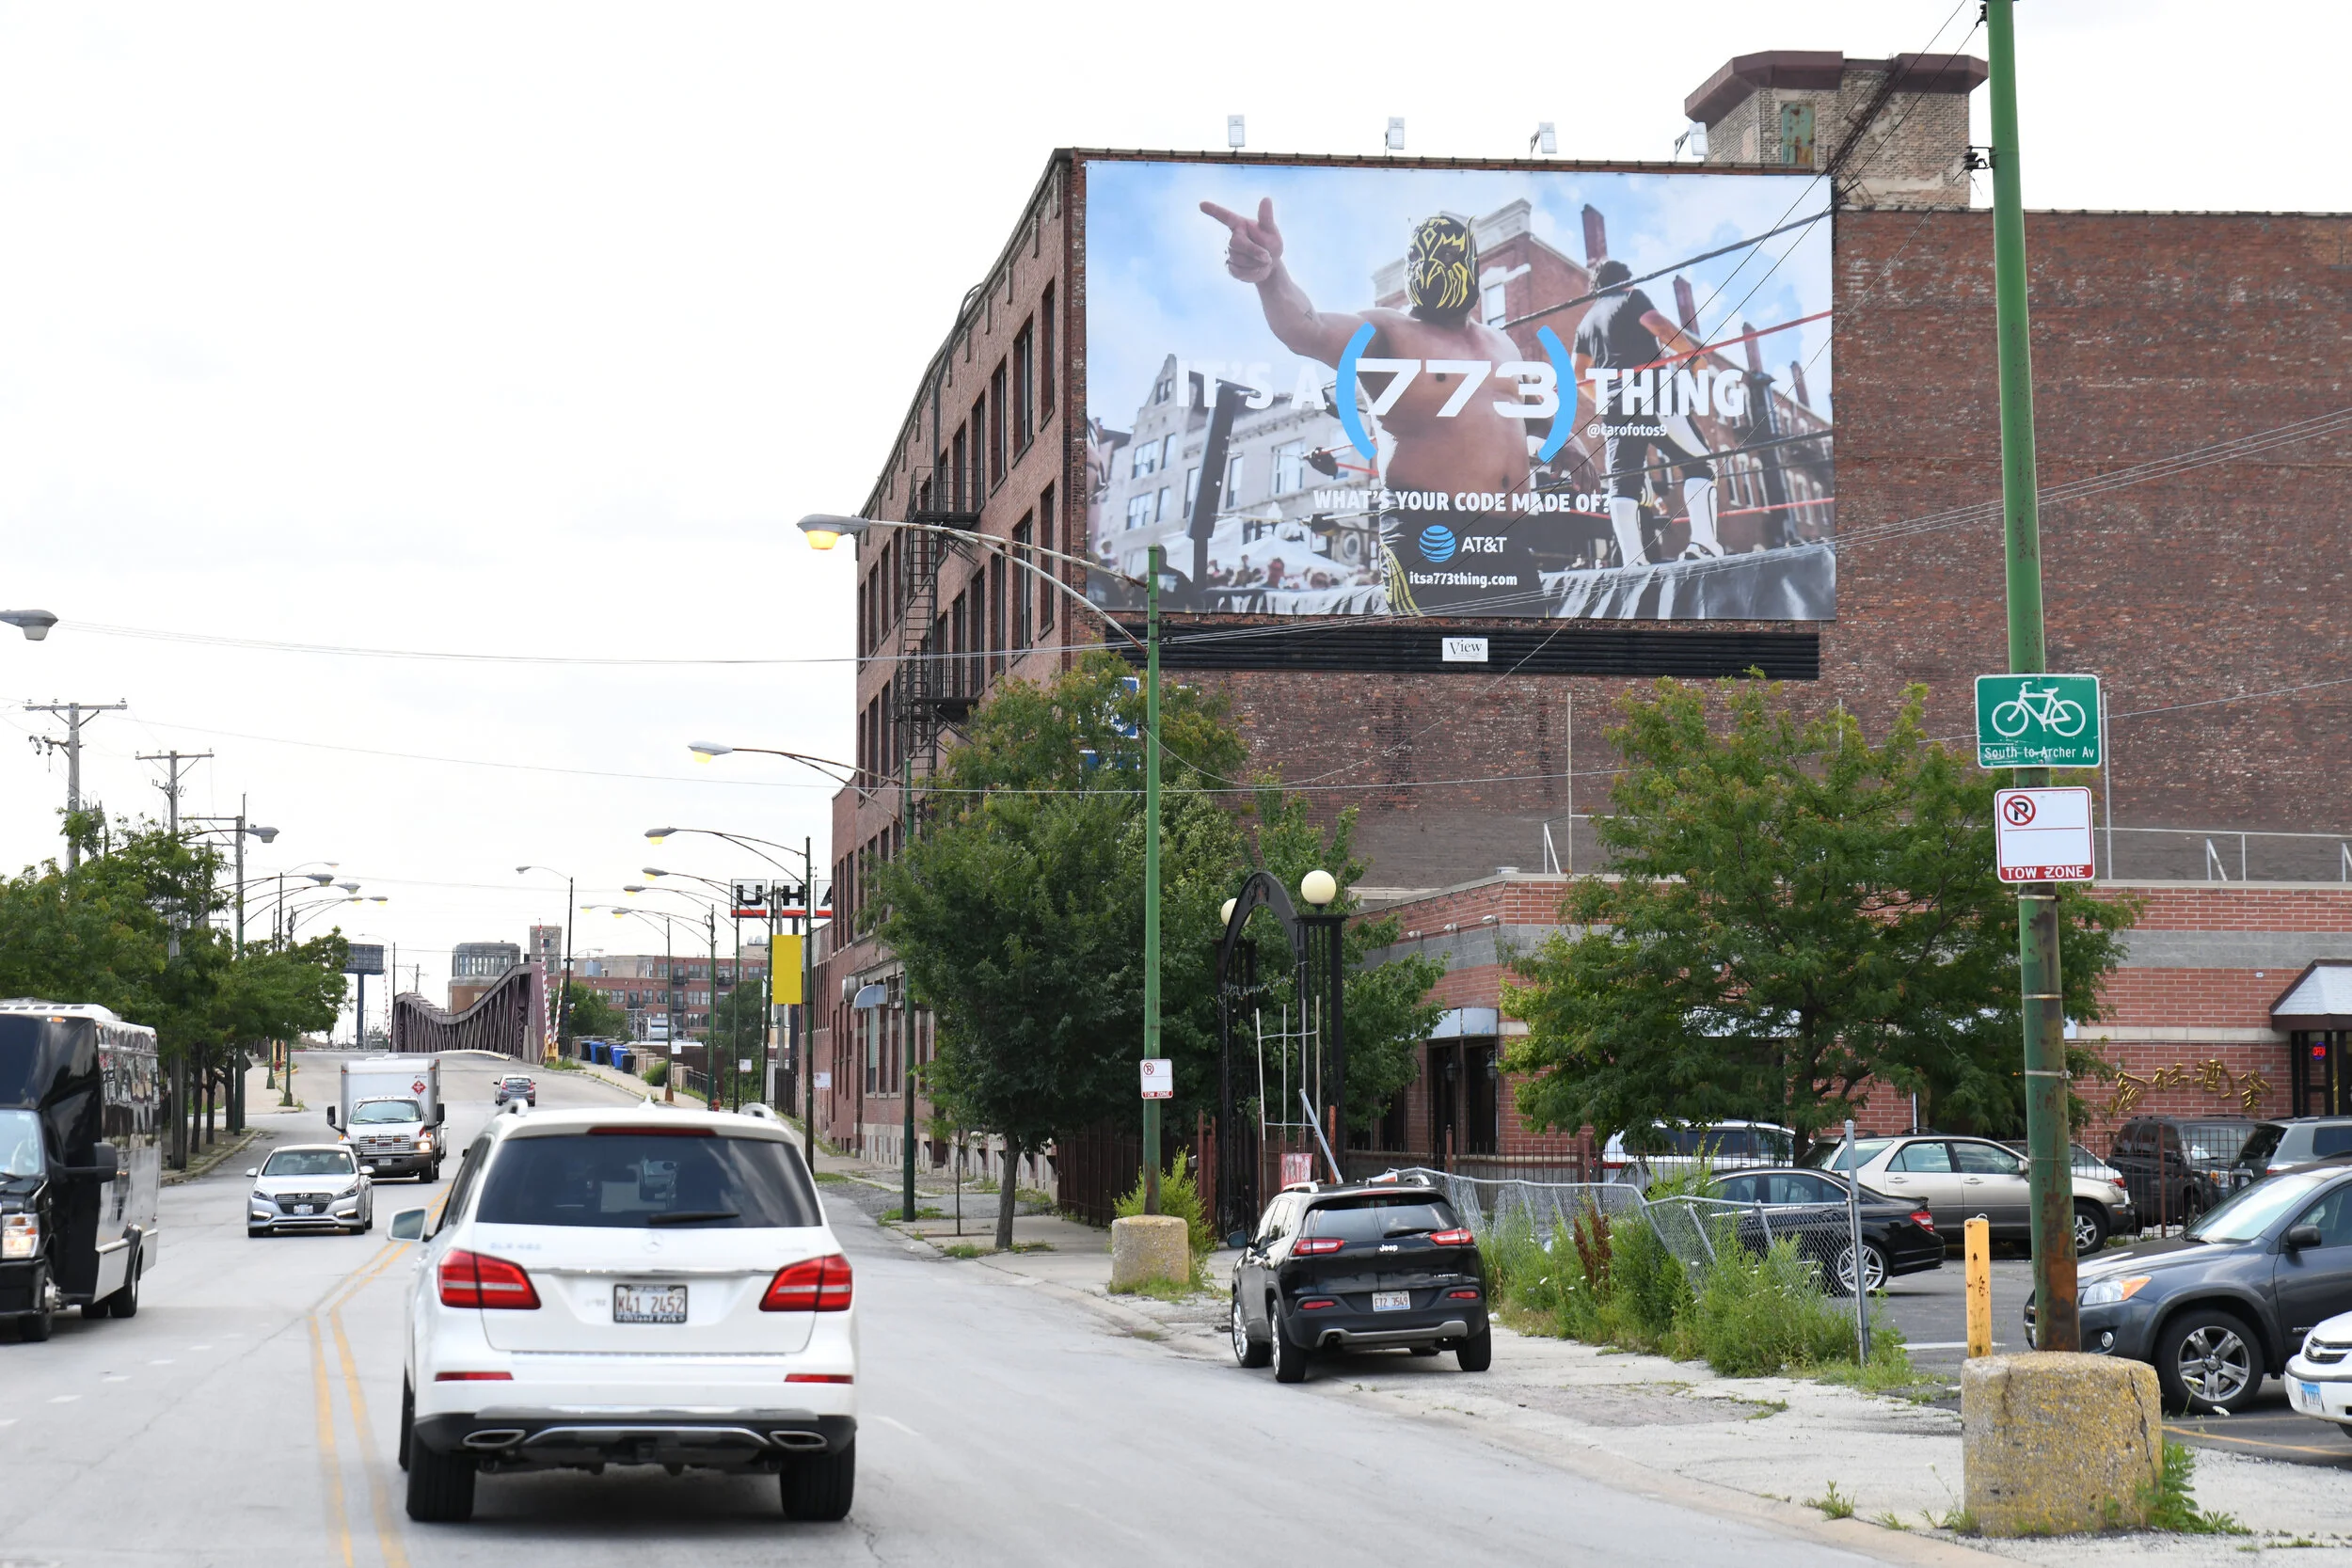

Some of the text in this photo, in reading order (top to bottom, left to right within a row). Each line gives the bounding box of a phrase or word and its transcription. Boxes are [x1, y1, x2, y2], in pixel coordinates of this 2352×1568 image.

[1176, 360, 1274, 410] IT'S
[1290, 362, 1327, 410] A
[1585, 368, 1745, 418] THING
[1586, 423, 1668, 438] @carofotos9
[1312, 489, 1612, 514] WHAT'S YOUR CODE MADE OF?
[1461, 536, 1507, 553] AT&T
[1409, 571, 1518, 588] itsa773thing.com
[1449, 640, 1483, 656] View
[1984, 746, 2095, 759] South to Archer Av
[2006, 865, 2086, 879] TOW ZONE
[1378, 1243, 1398, 1253] Jeep
[617, 1295, 641, 1313] K41
[651, 1295, 685, 1314] 2452
